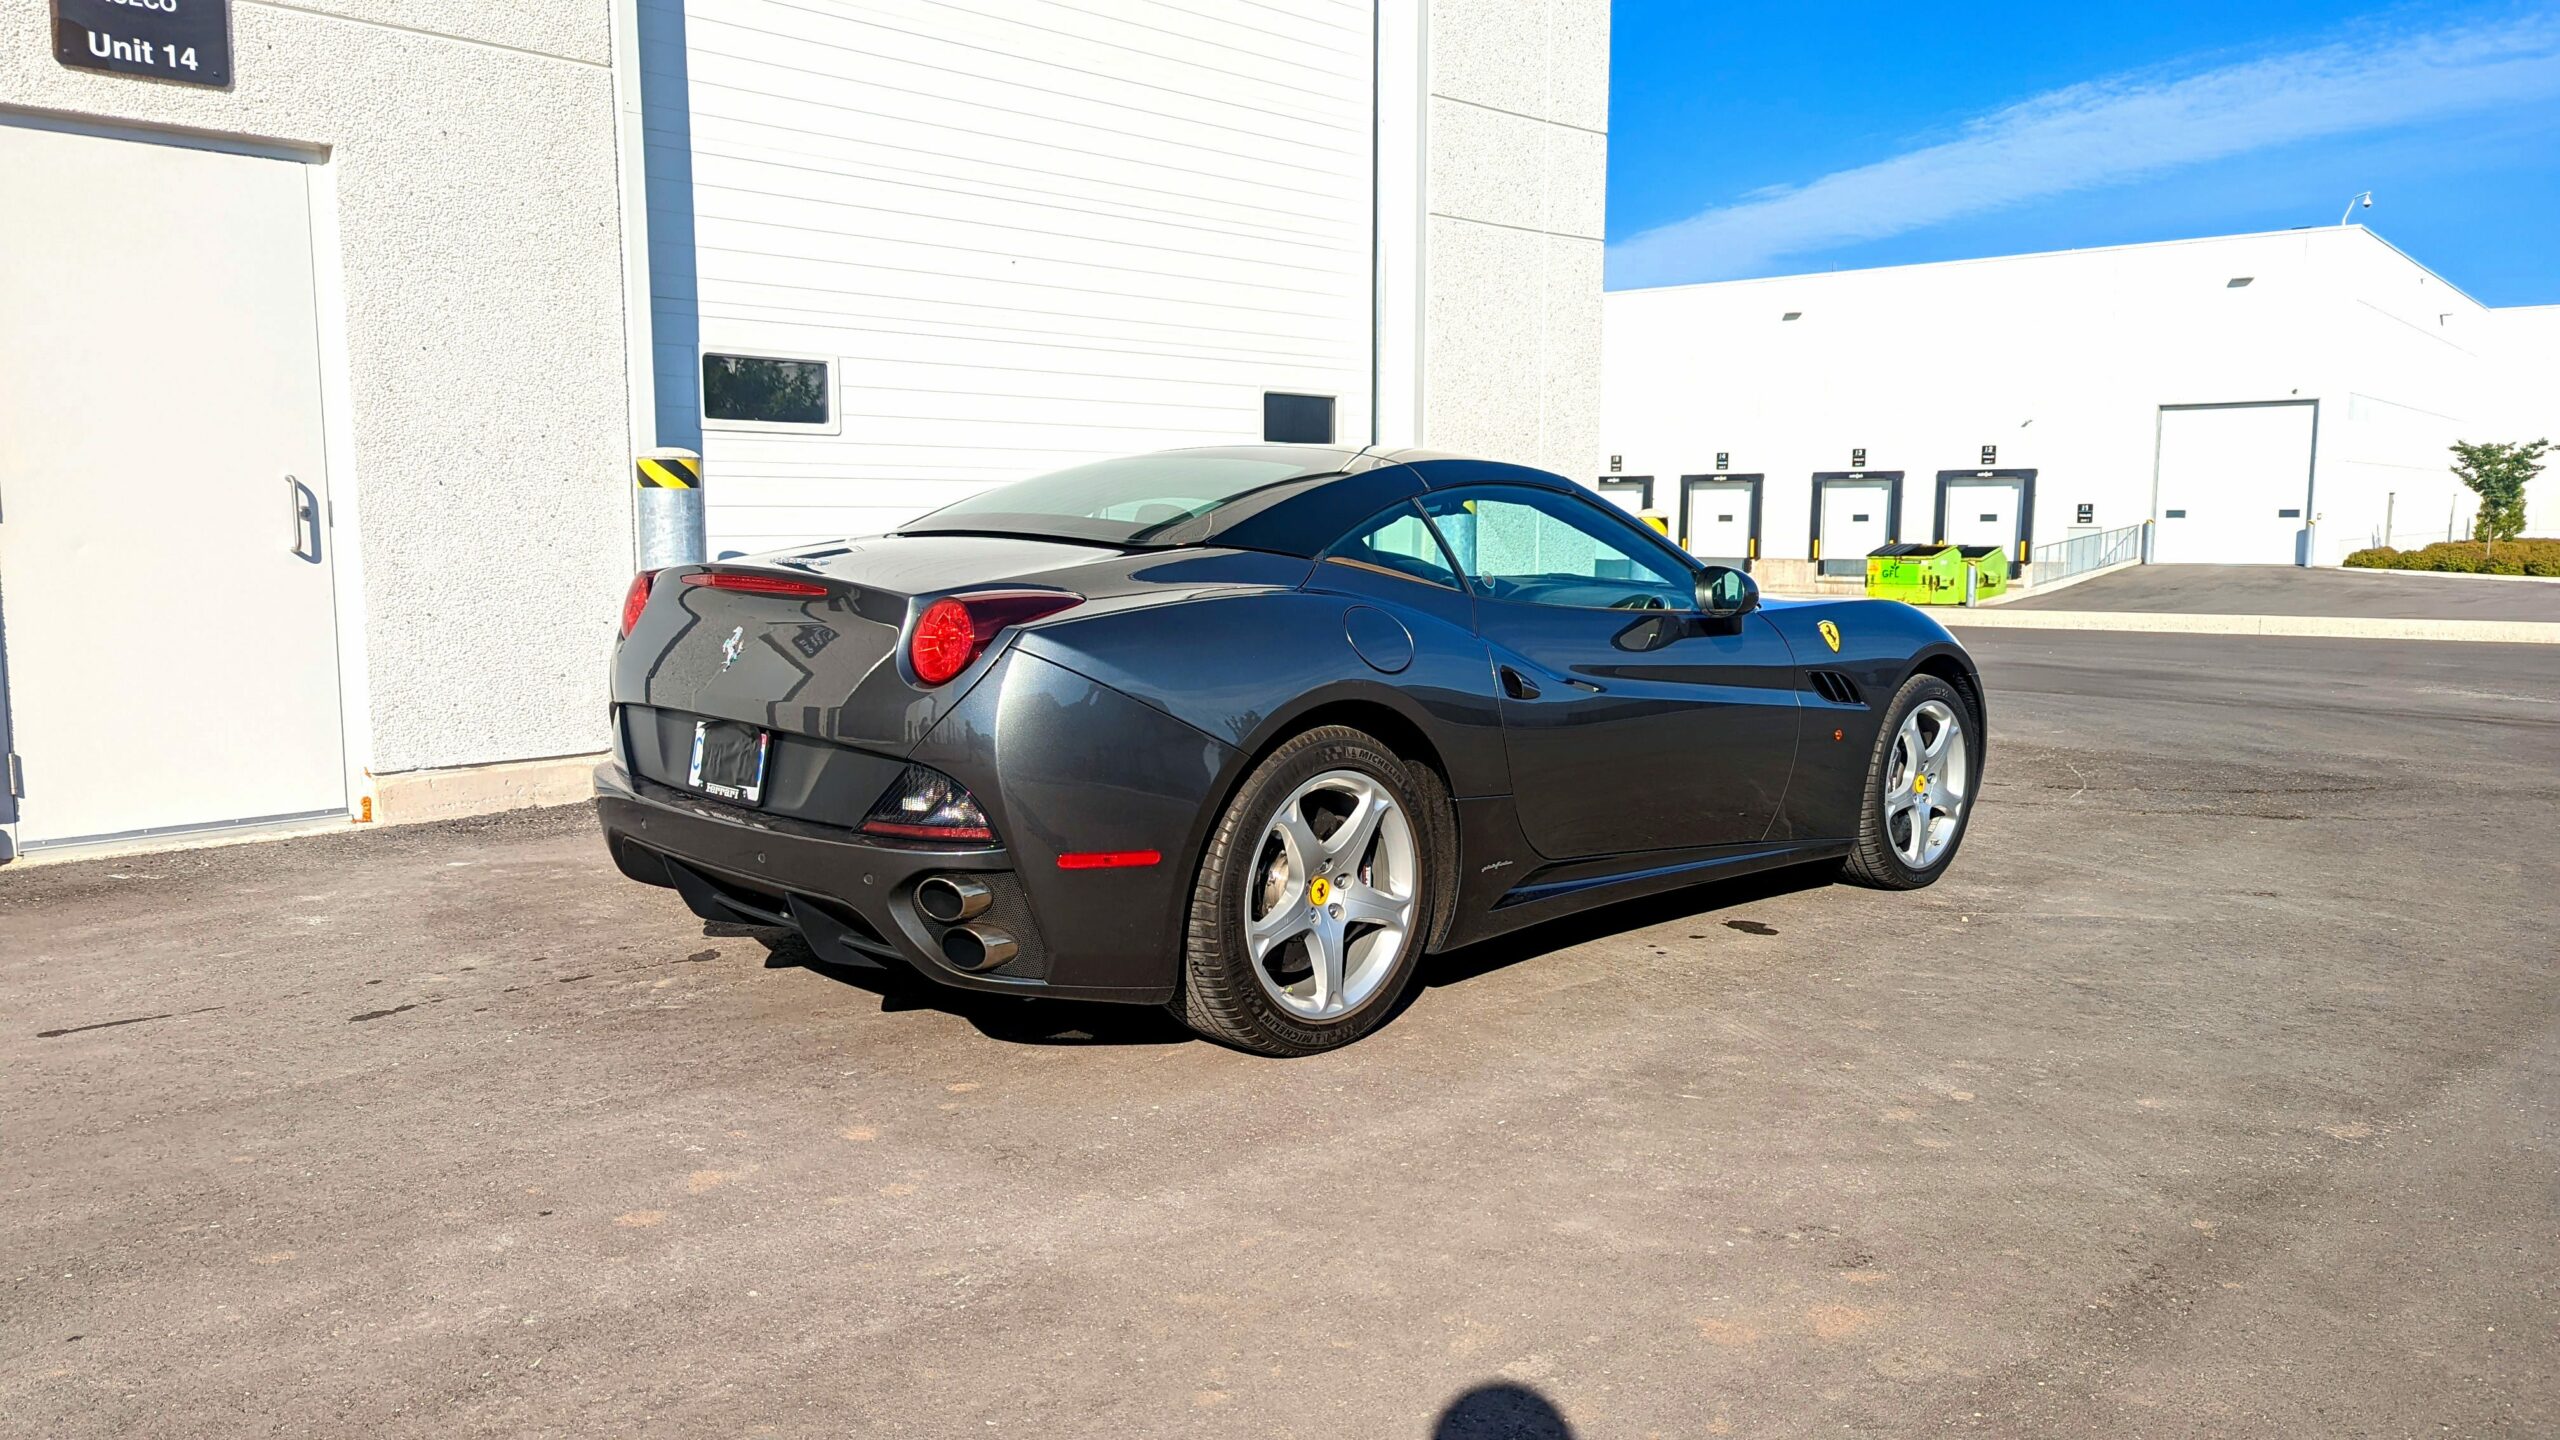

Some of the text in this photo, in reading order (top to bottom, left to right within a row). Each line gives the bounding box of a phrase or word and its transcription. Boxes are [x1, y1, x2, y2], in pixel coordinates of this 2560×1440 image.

[87, 30, 199, 71] Unit 14
[1358, 749, 1405, 786] MICHELIN
[705, 782, 740, 800] Ferrari
[1260, 1011, 1314, 1043] MICHELIN
